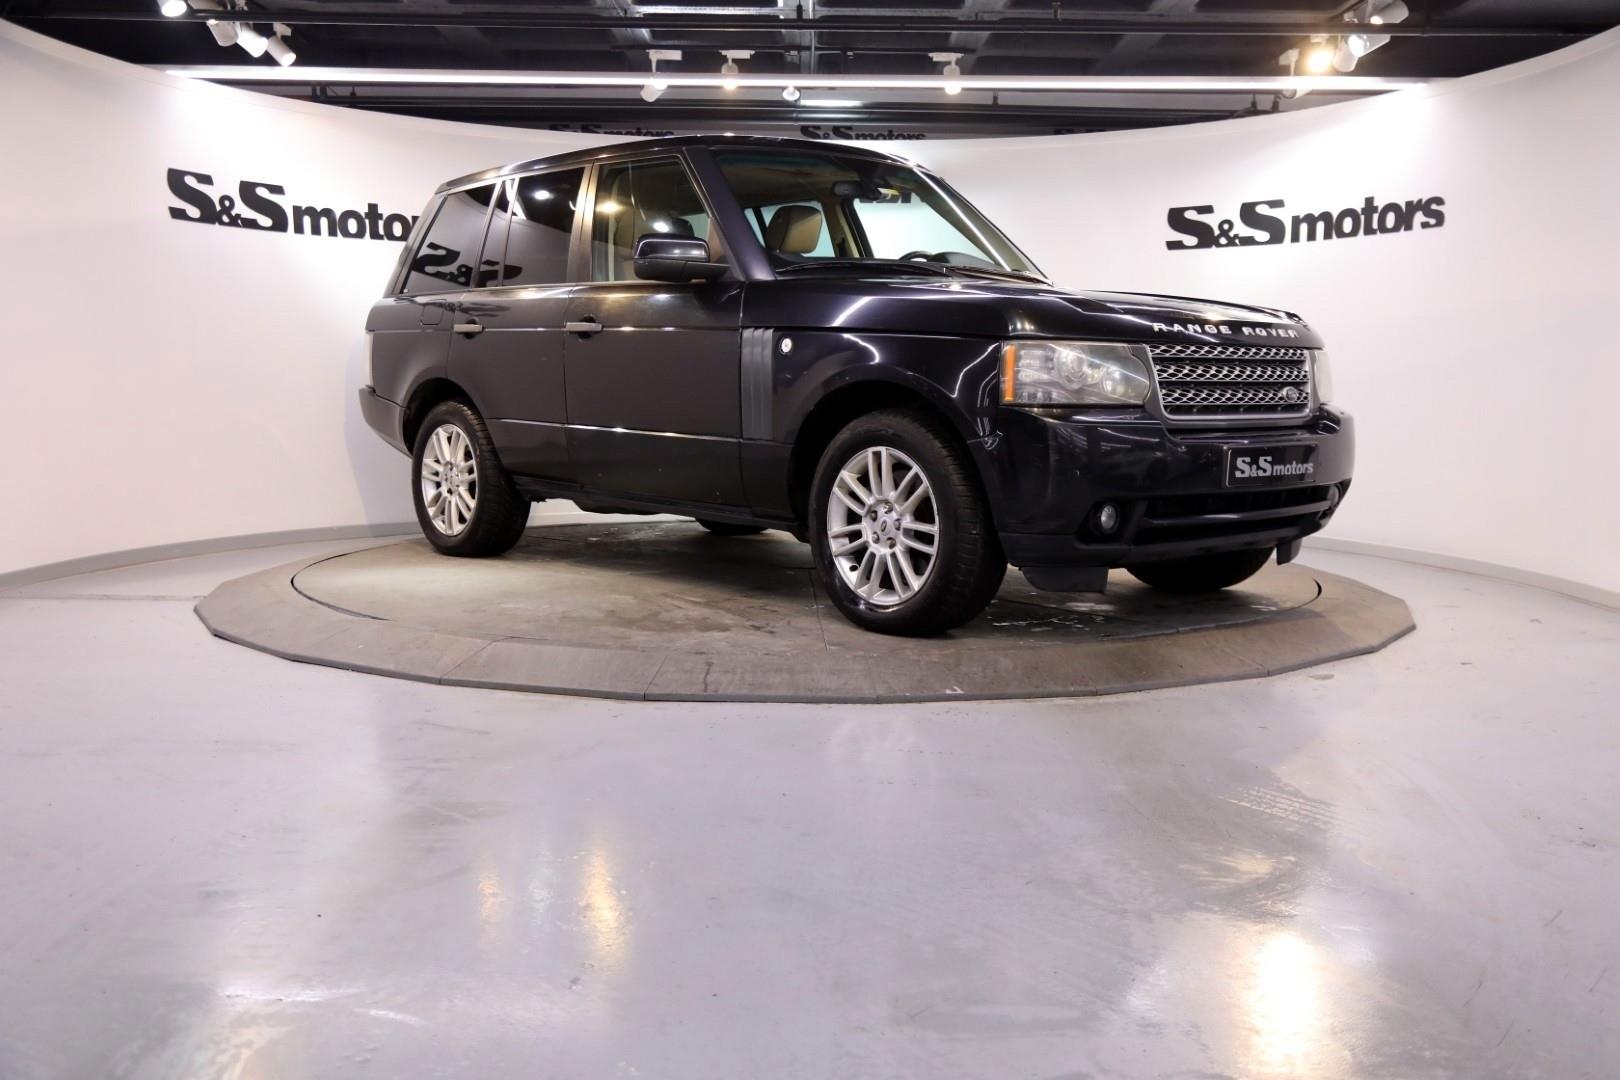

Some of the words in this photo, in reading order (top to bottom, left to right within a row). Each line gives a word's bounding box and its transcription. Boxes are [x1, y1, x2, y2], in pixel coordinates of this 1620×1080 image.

[167, 168, 288, 233] S&S
[293, 203, 420, 242] moto
[1166, 199, 1286, 250] S&S
[1290, 196, 1446, 243] motors
[1152, 322, 1232, 334] RANGE
[1242, 326, 1299, 338] ROVER
[1235, 456, 1273, 478] S&S
[1273, 460, 1314, 476] motors
